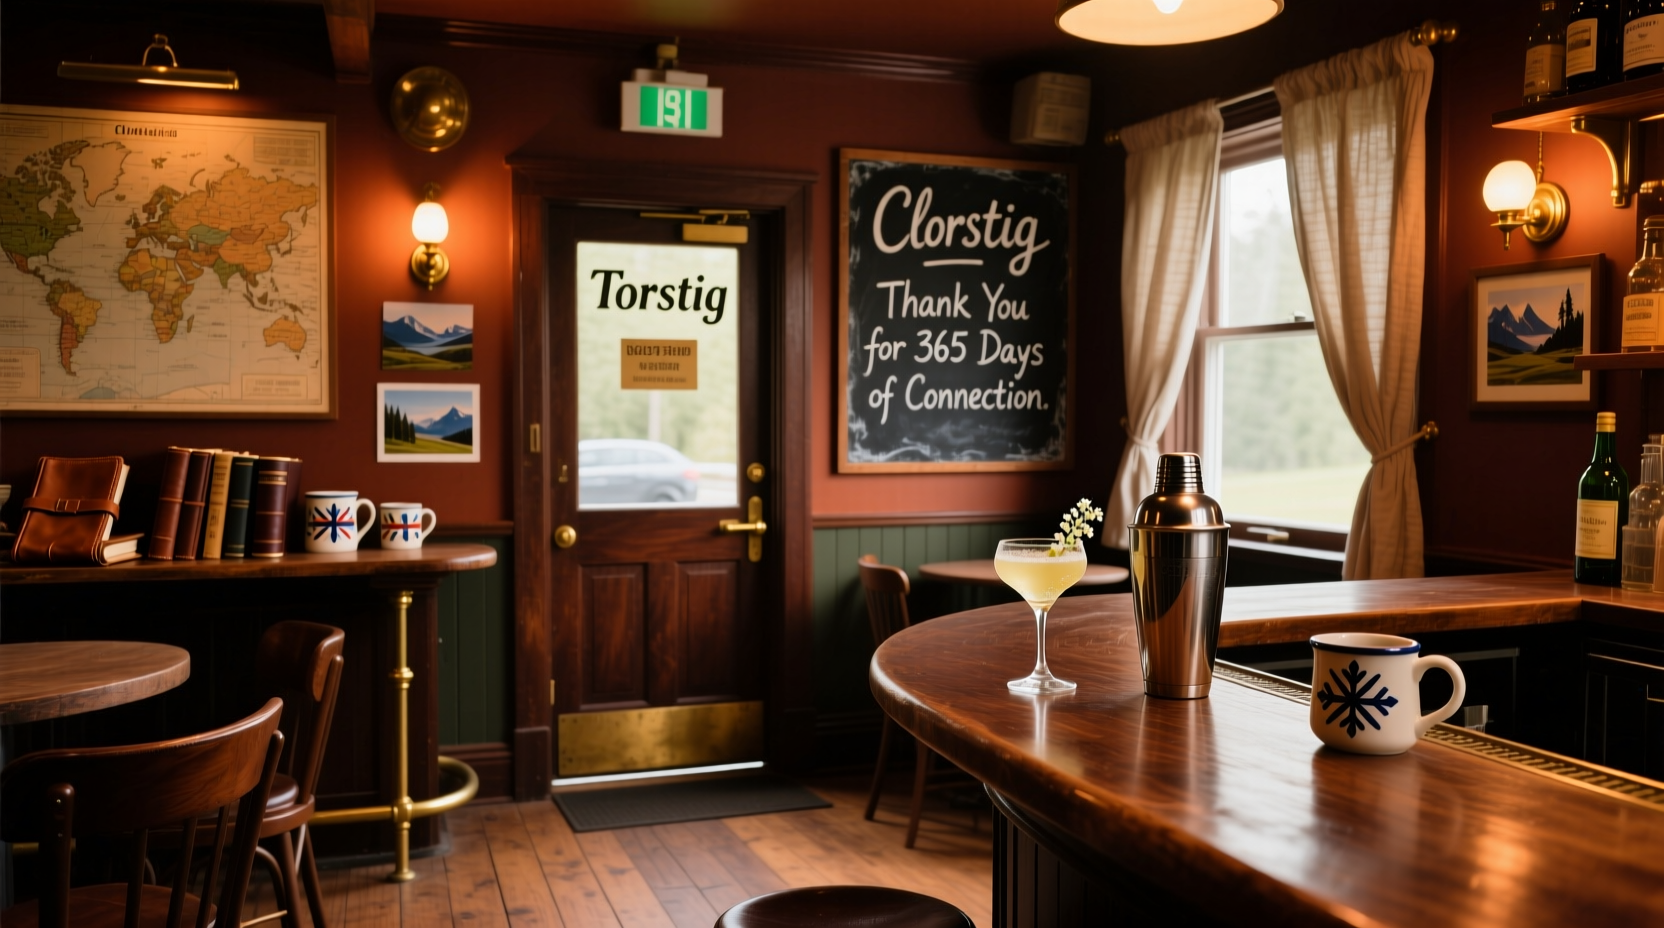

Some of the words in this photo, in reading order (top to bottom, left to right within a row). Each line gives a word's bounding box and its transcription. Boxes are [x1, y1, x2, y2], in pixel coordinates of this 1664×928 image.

[873, 185, 1050, 276] Clorstig
[590, 269, 728, 325] Torstig
[876, 279, 972, 319] Thank
[981, 282, 1030, 322] You
[863, 326, 907, 377] for
[913, 329, 969, 363] 365
[977, 328, 1044, 380] Days
[868, 375, 898, 425] of
[905, 373, 1050, 411] Connection.
